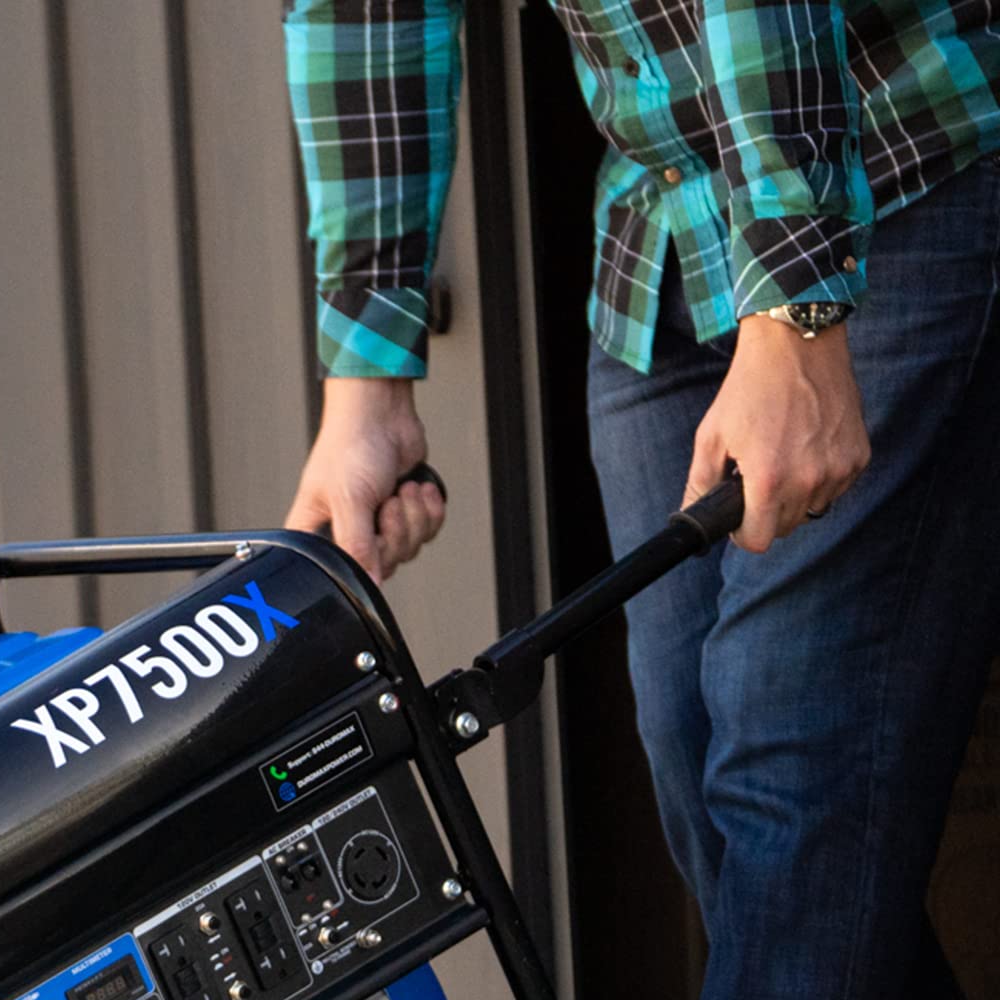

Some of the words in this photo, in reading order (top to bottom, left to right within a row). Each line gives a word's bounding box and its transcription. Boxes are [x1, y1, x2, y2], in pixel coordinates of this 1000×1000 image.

[10, 580, 300, 768] XP7500X
[278, 829, 307, 850] BREAKER
[194, 882, 218, 900] OUTLET
[71, 947, 113, 975] MULTIMETER
